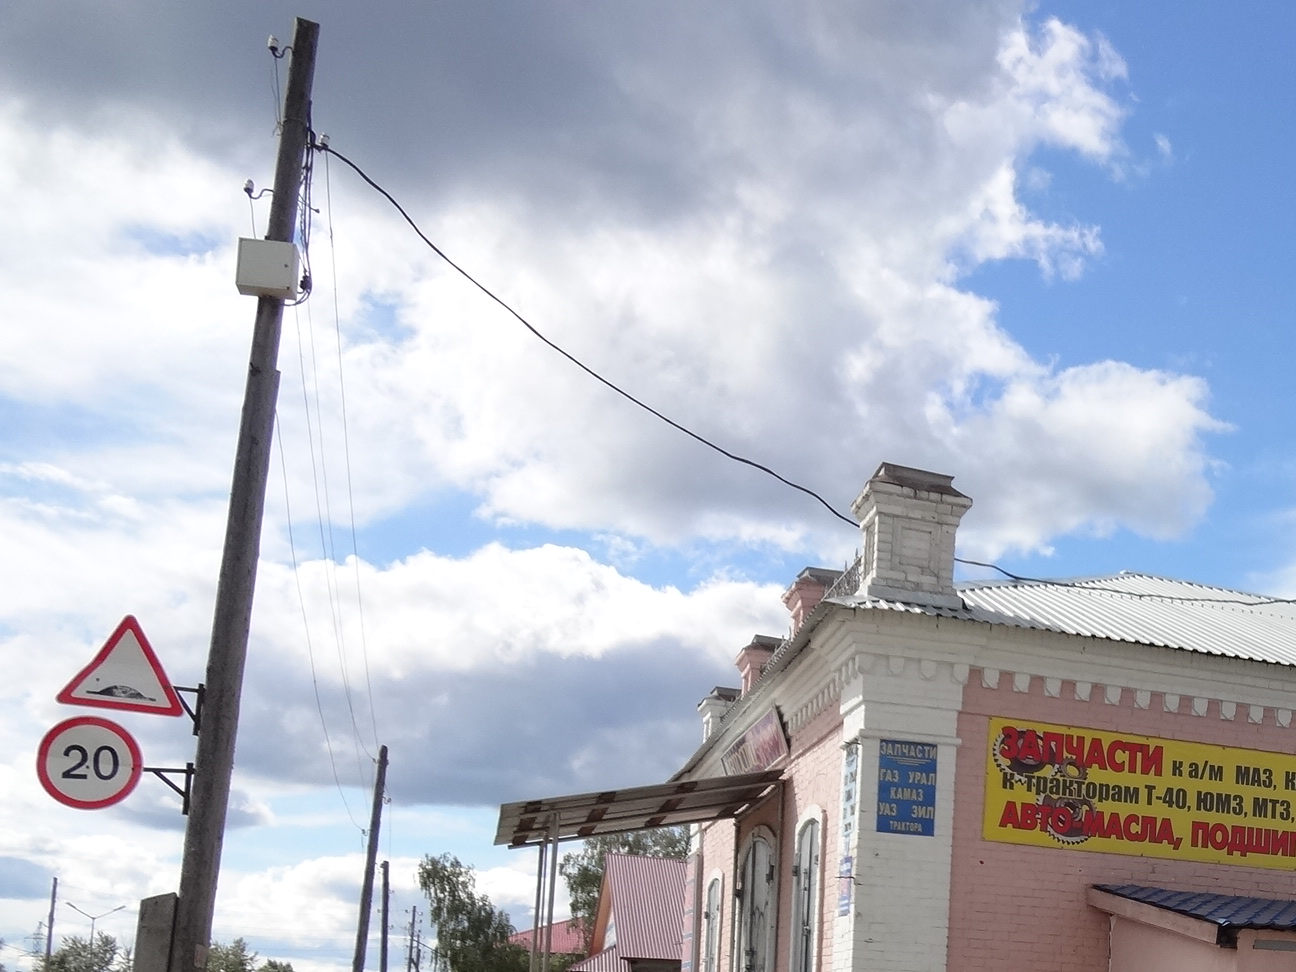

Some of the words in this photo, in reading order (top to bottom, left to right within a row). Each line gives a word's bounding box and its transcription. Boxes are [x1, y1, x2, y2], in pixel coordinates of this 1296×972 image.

[880, 742, 938, 759] ЗАПЧАСТИ
[1000, 726, 1163, 777] ЗАПЧАСТИ
[1188, 761, 1224, 782] а/м
[1235, 765, 1277, 791] МАЗ,
[61, 744, 119, 780] 20
[880, 768, 899, 783] ГАЗ
[908, 771, 936, 786] УРАЛ
[889, 787, 924, 802] КАМАЗ
[1024, 774, 1140, 804] тракторам
[1145, 785, 1191, 812] Т-40,
[1196, 790, 1248, 818] ЮМЗ,
[1252, 797, 1295, 823] МТЗ,
[879, 802, 897, 816] УАЗ
[911, 805, 935, 819] ЗИЛ
[890, 820, 923, 832] ТРАКТОРА
